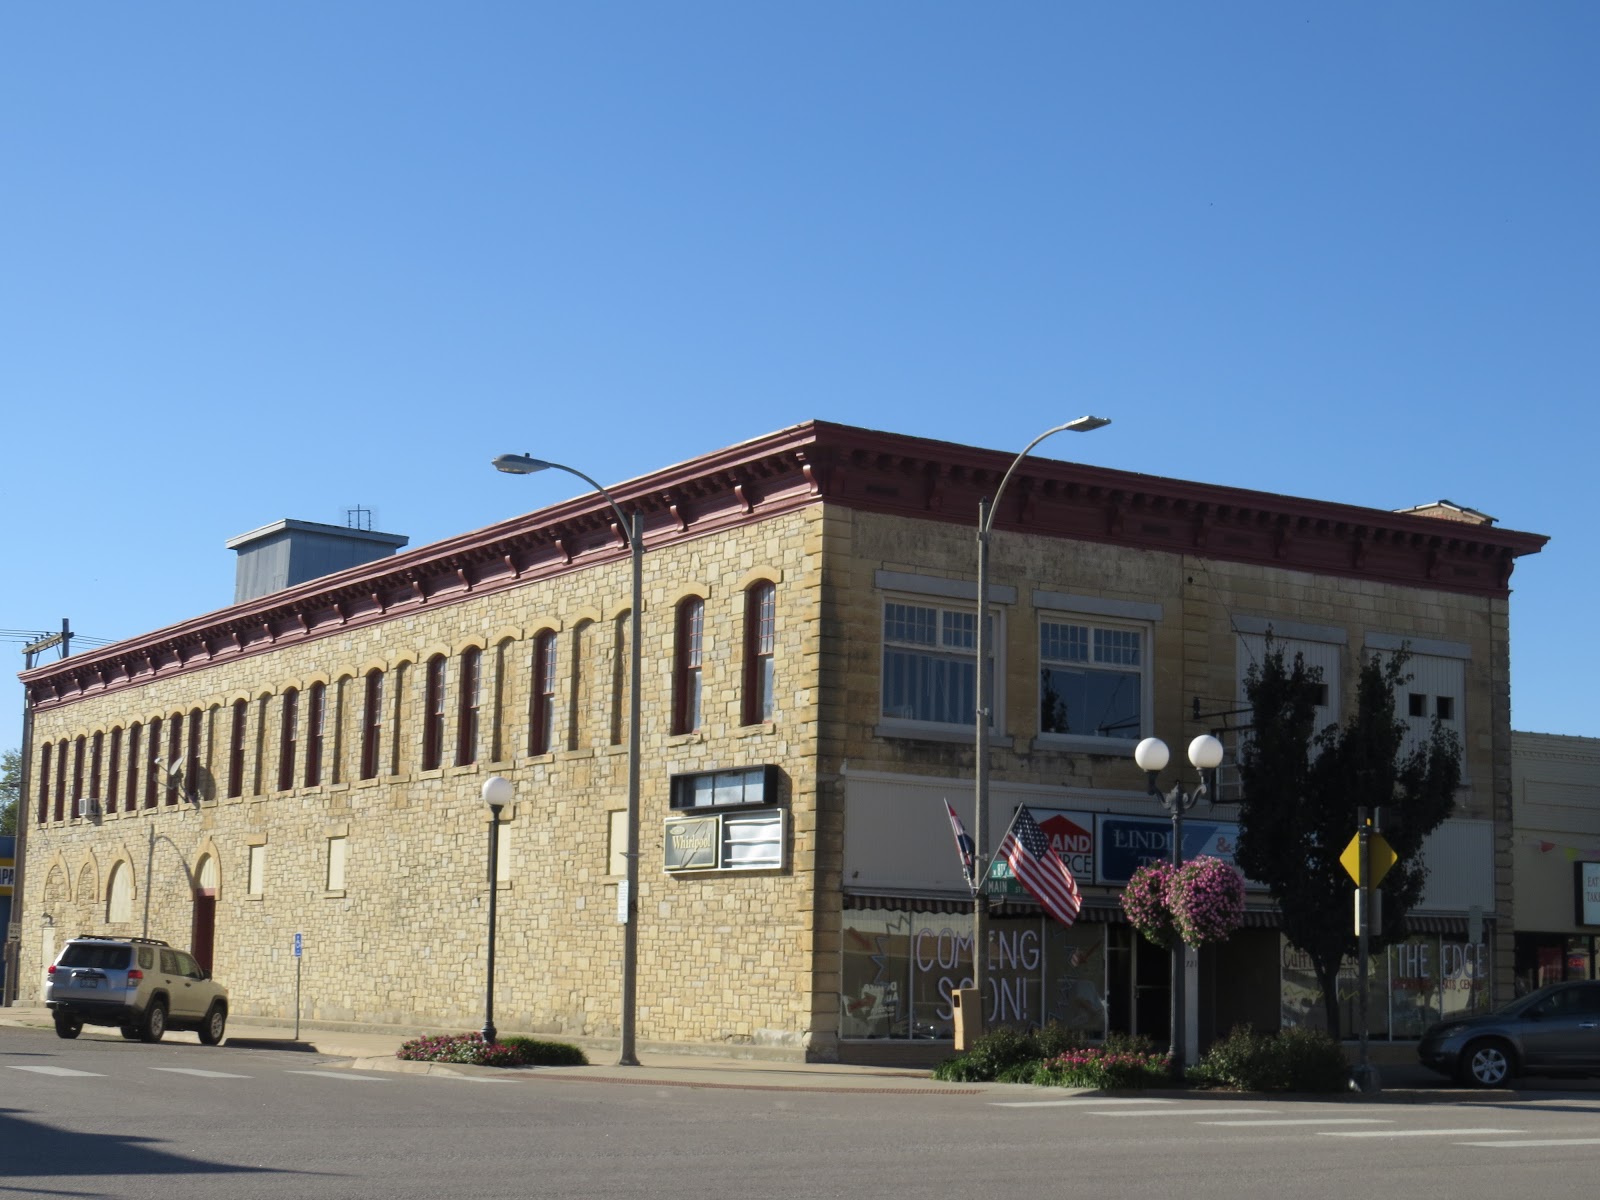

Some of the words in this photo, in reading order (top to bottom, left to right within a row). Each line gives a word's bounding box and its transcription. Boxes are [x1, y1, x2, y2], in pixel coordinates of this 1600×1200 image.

[672, 833, 711, 852] Whirlpool
[1049, 833, 1091, 852] AND
[1058, 854, 1091, 874] RCE
[0, 869, 14, 885] PA
[988, 881, 1008, 893] MAIN
[1396, 943, 1430, 978] THE
[936, 976, 1027, 1021] SON!
